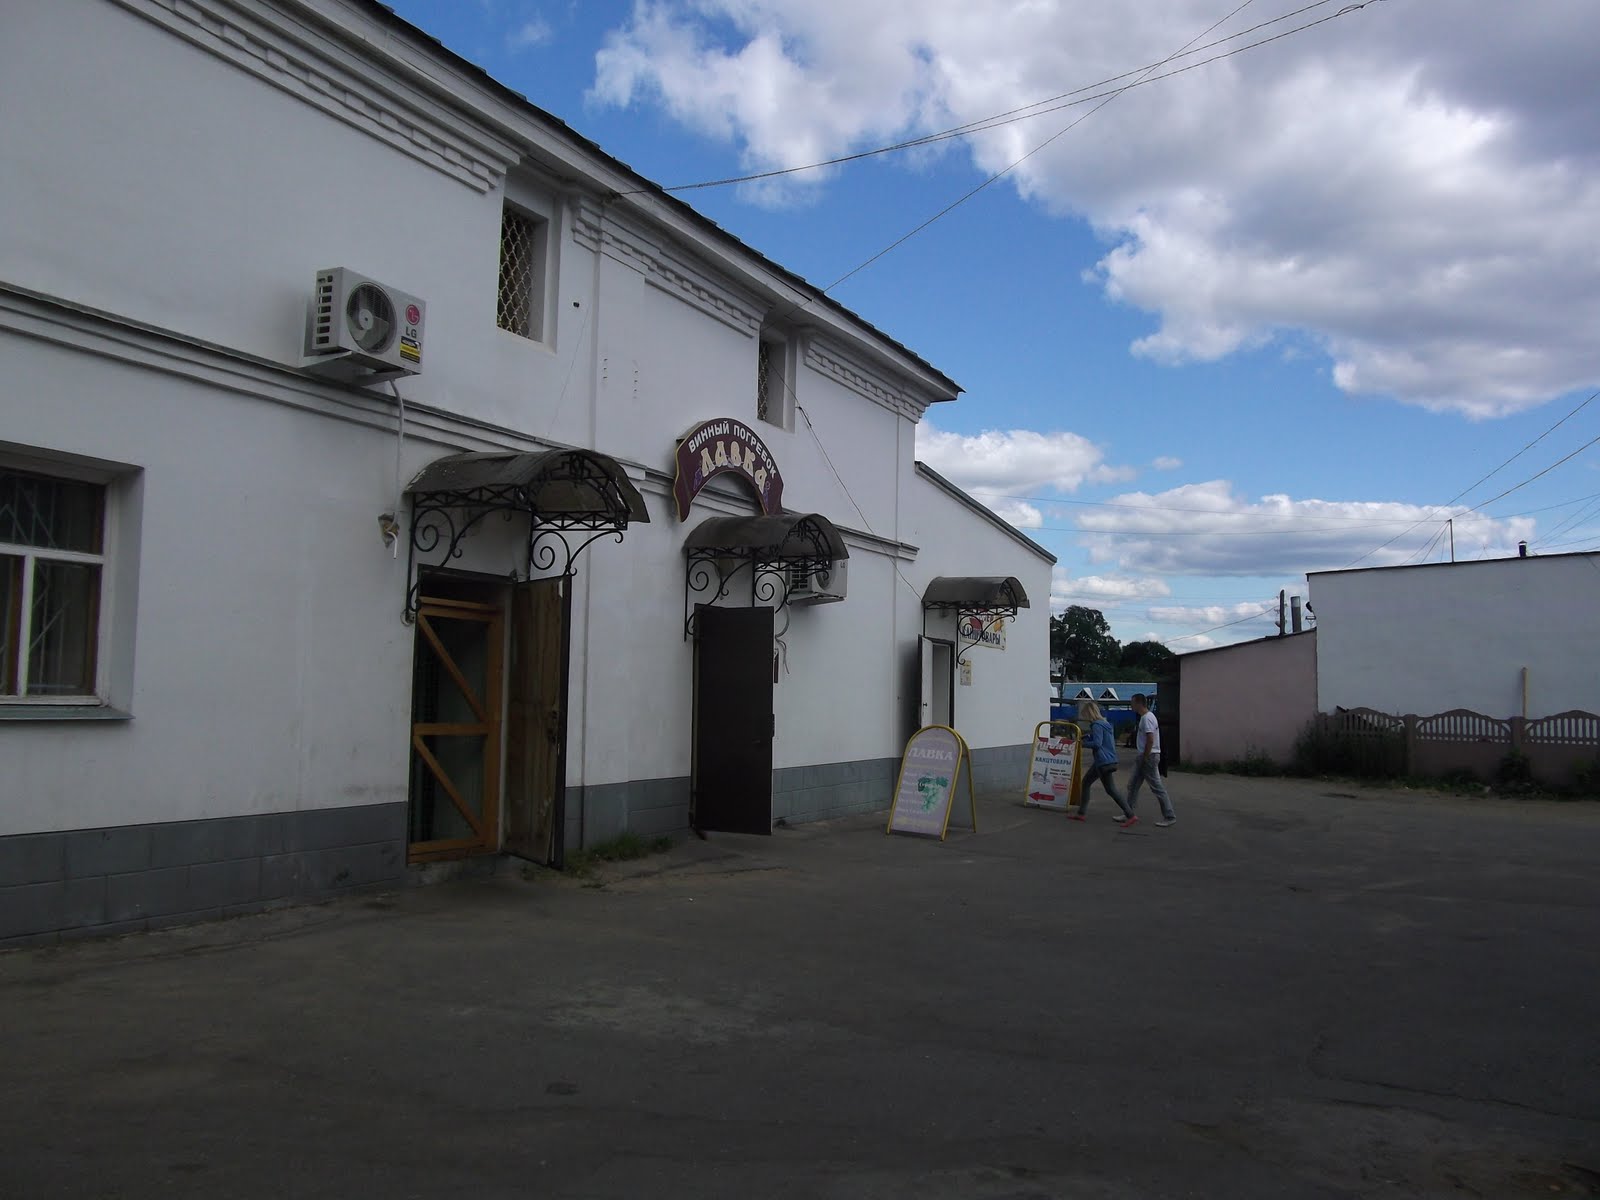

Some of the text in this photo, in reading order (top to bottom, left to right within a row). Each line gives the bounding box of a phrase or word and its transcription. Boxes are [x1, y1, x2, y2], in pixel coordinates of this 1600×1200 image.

[405, 326, 417, 339] LG
[688, 420, 777, 479] ВИННЫЙ ПОГРЕБОК
[700, 440, 768, 495] ЛАВКА
[908, 747, 953, 760] ЛАВКА
[1035, 756, 1072, 766] КАНЦТОВАРЫ
